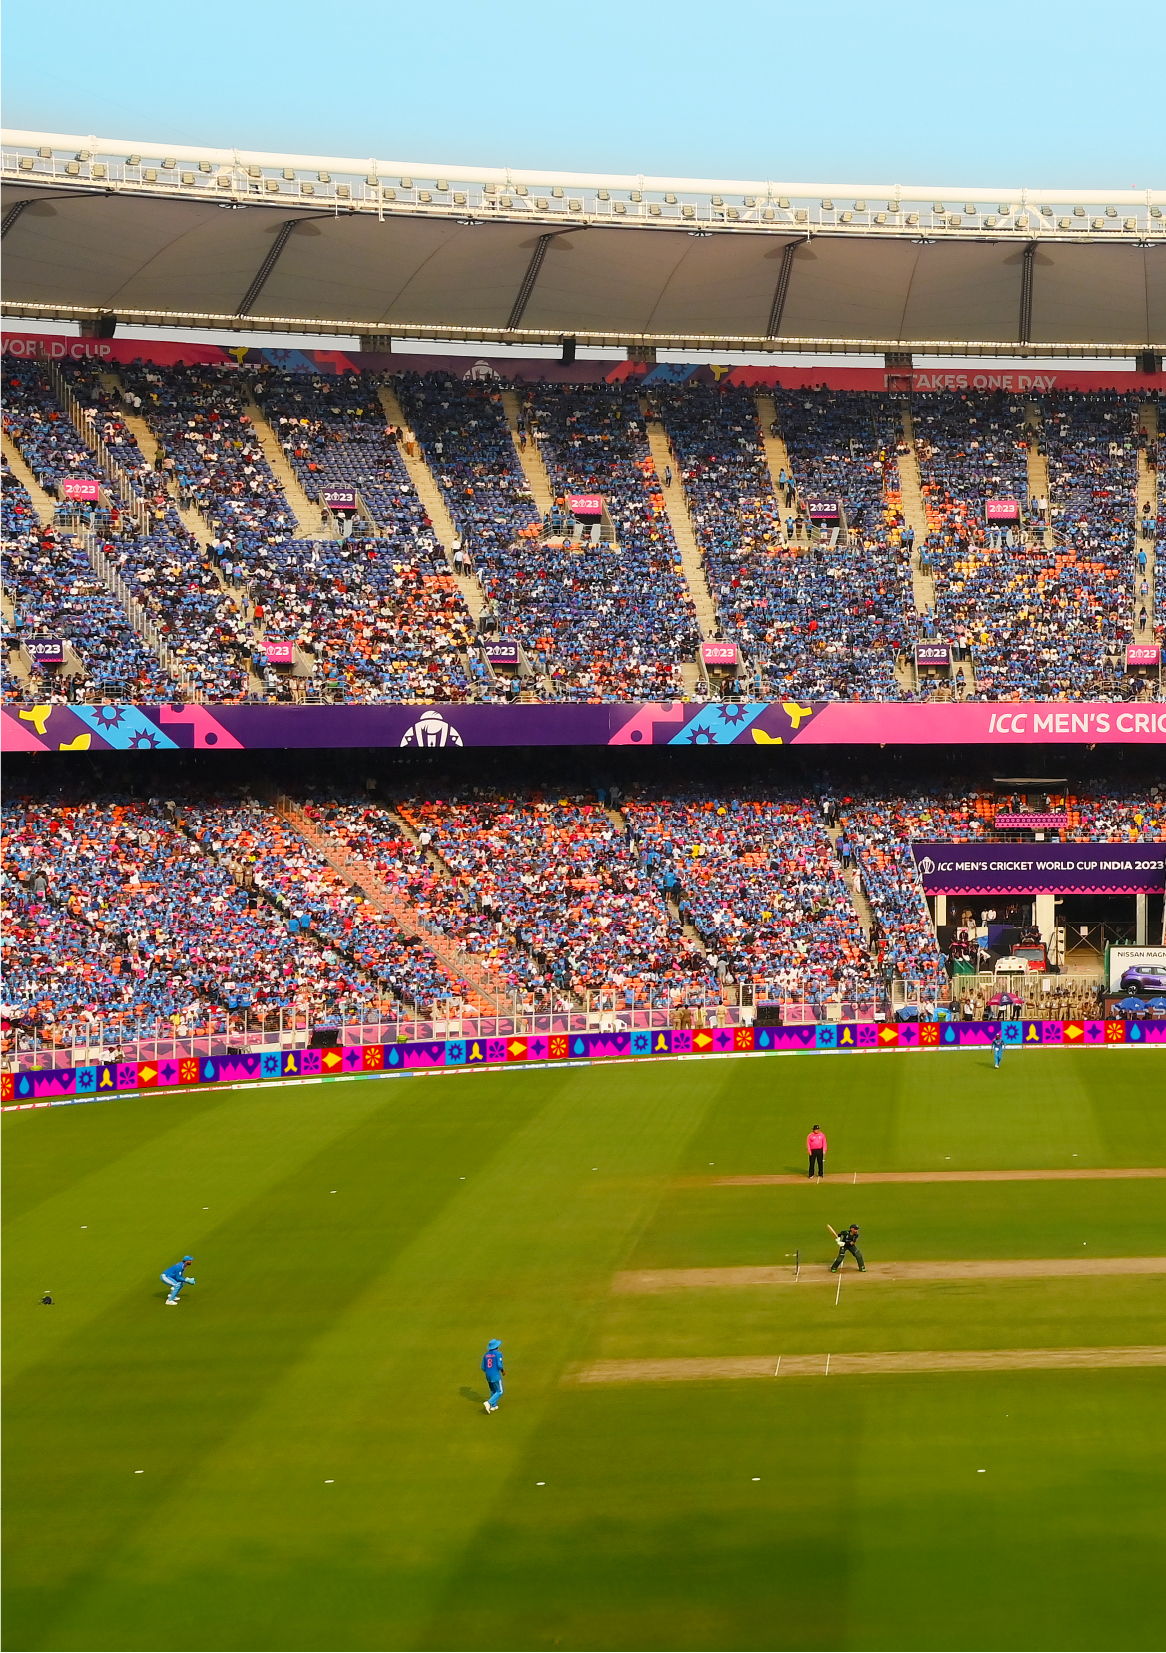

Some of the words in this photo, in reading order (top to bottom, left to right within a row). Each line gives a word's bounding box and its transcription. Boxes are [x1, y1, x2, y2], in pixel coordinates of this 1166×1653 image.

[71, 343, 111, 358] CUP
[973, 375, 1013, 389] ONE
[1018, 375, 1057, 389] DAY
[988, 713, 1027, 733] ICC
[1033, 713, 1110, 733] MEN'S
[937, 862, 953, 871] ICC
[955, 862, 988, 871] MEN'S
[989, 861, 1033, 871] CRICKET
[1036, 861, 1075, 870] WORLD
[1076, 861, 1098, 870] CUP
[1100, 861, 1133, 870] INDIA
[1134, 861, 1164, 870] 2023
